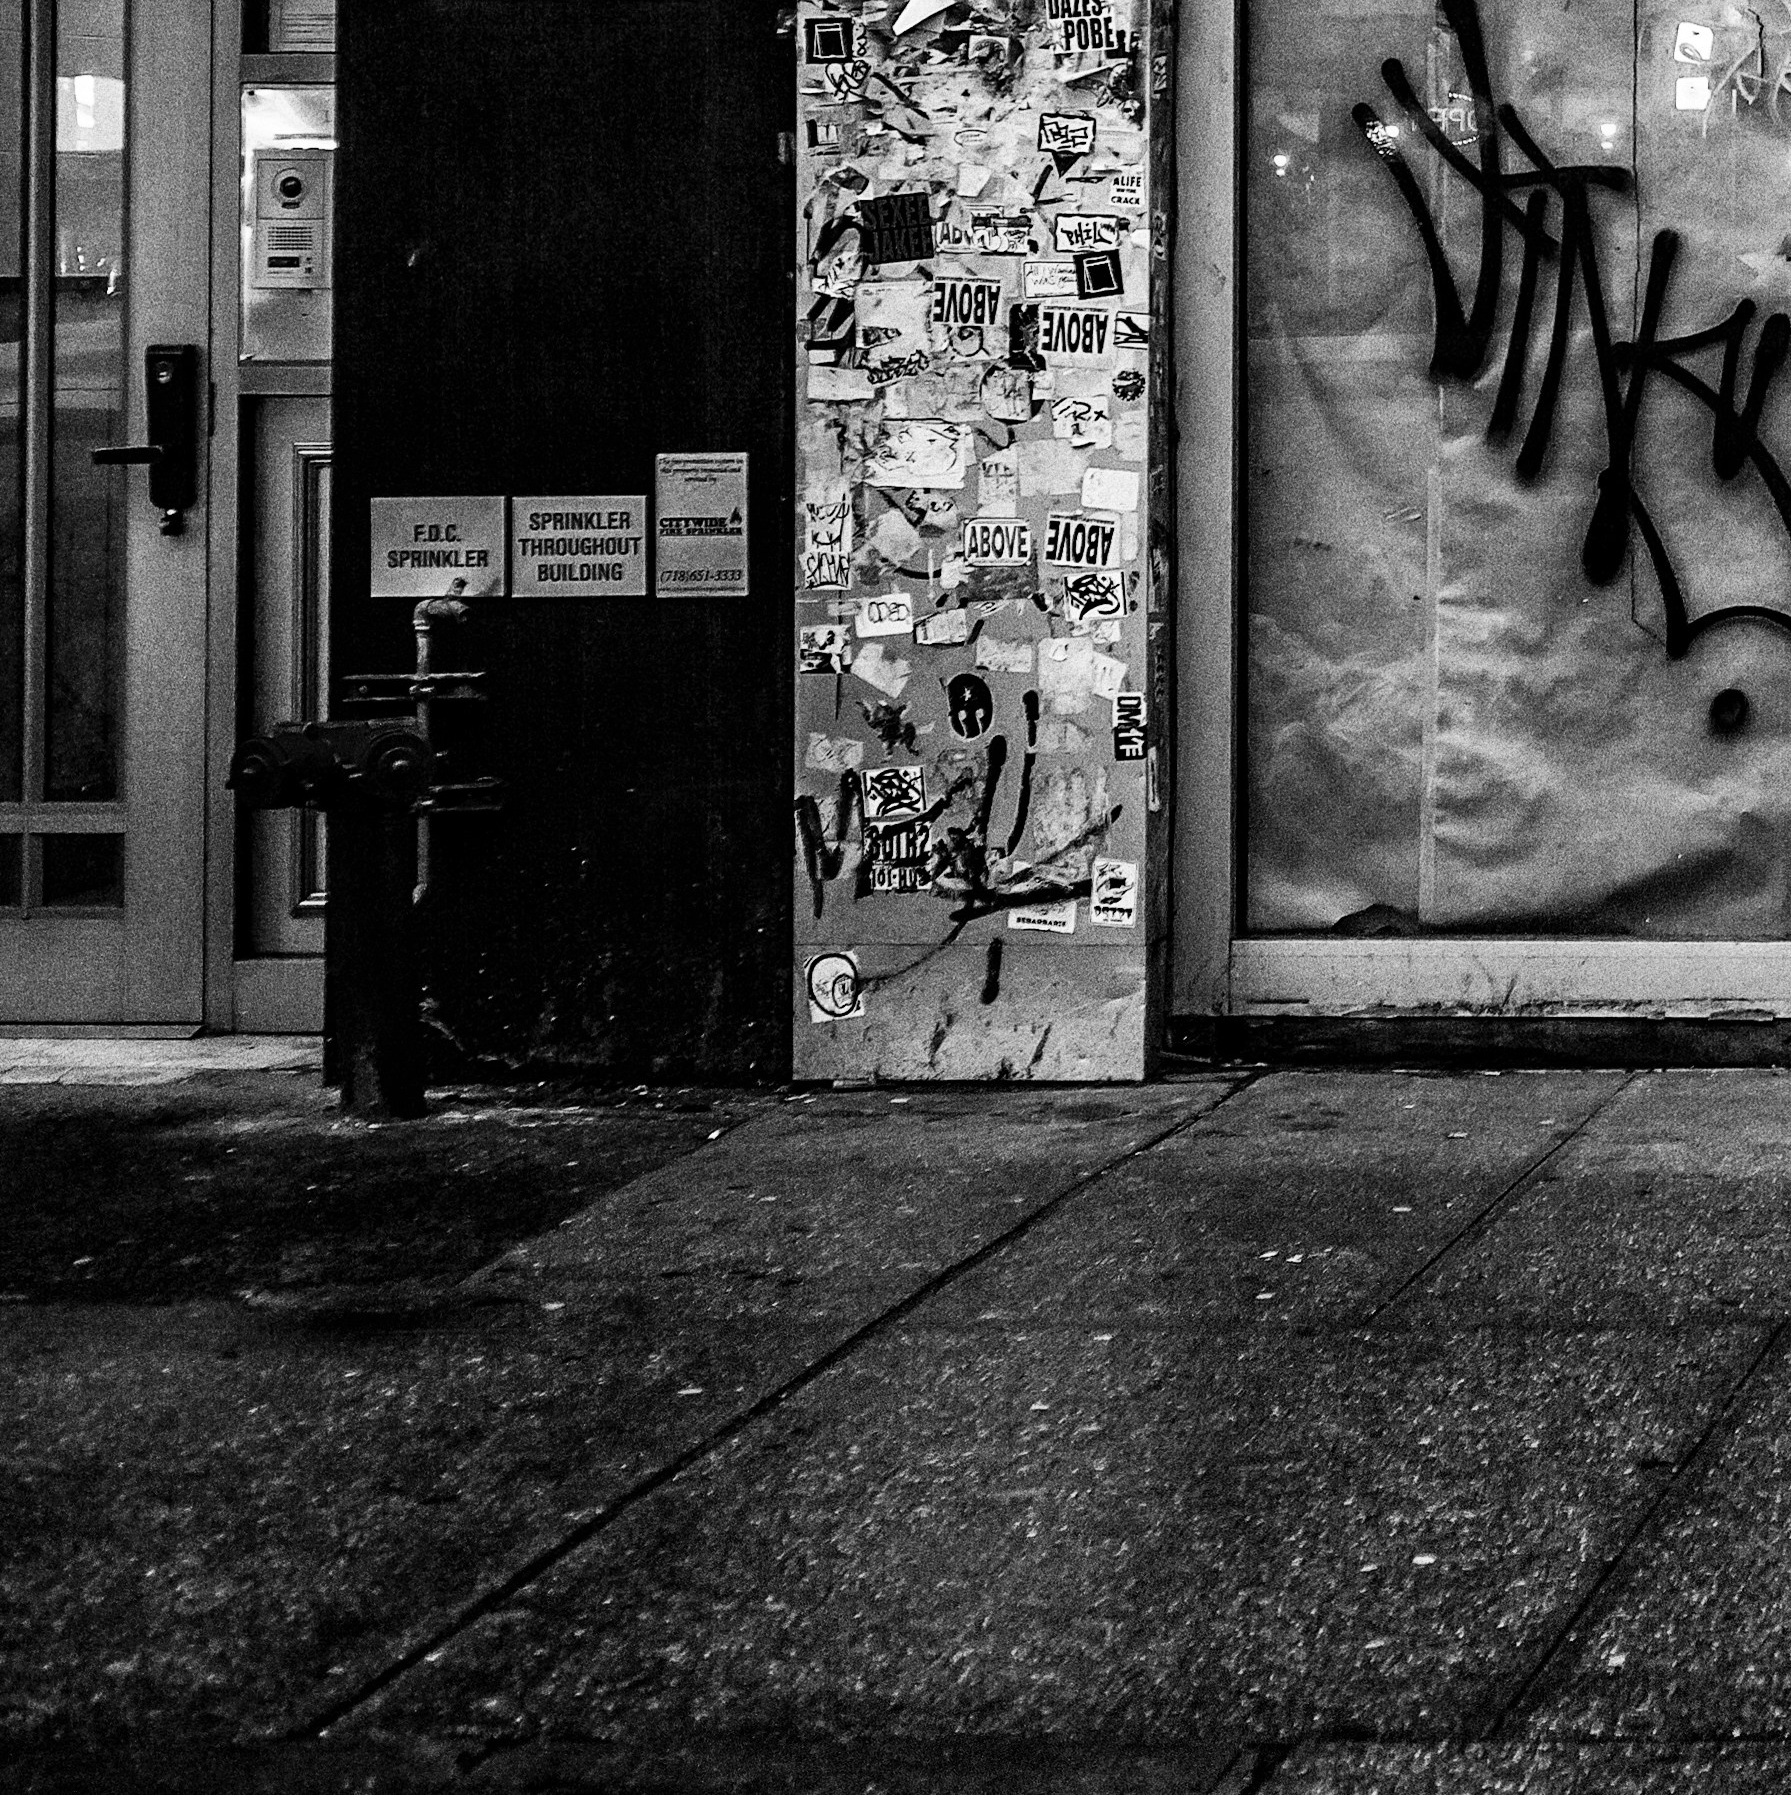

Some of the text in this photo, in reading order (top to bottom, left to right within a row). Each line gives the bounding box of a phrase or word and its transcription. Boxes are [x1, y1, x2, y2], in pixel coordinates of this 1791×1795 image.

[932, 282, 1001, 325] ABOVE
[1041, 311, 1109, 354] ABOVE
[528, 512, 631, 531] SPRINKLER
[660, 517, 729, 527] CITYWIDE
[413, 524, 461, 543] F.D.C.
[969, 525, 1029, 558] ABOVE
[1046, 521, 1115, 566] ABOVE
[518, 536, 643, 557] THROUGHOUT
[387, 550, 488, 568] SPRINKLER
[537, 562, 623, 582] BUILDING
